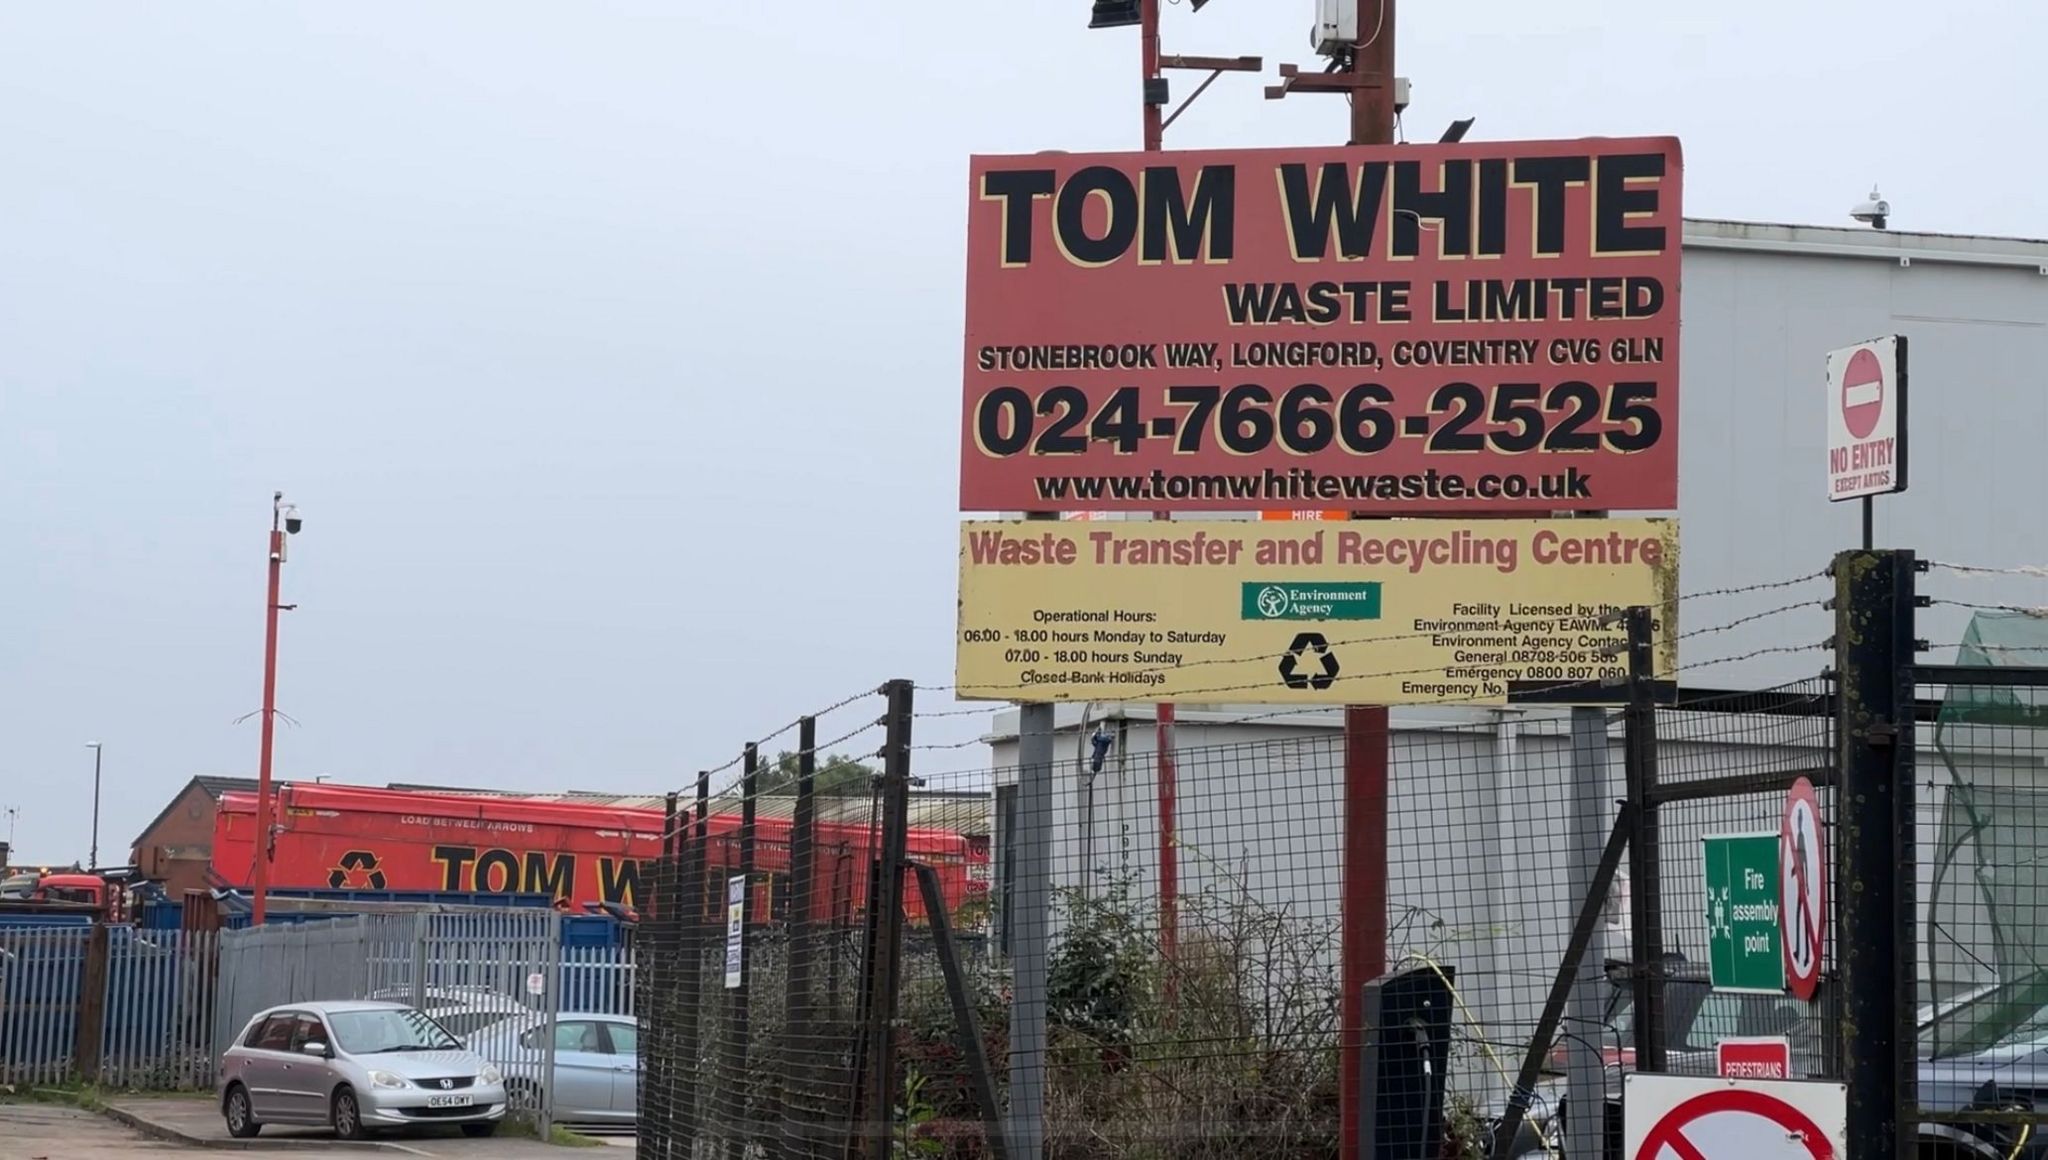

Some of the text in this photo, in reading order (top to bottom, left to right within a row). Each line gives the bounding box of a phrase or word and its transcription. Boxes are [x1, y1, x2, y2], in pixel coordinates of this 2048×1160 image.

[979, 153, 1667, 268] TOM WHITE
[1224, 276, 1664, 326] WASTE LIMITED
[978, 337, 1664, 373] STONEBROOK WAY, LONGFORD, COVENTRY CV6 6LN
[973, 381, 1663, 459] 024-7666-2525
[1830, 437, 1894, 474] NO ENTRY
[1035, 466, 1592, 502] www.tomwhitewaste.co.uk
[1835, 470, 1890, 493] EXCEPT ARTICS
[969, 530, 1664, 573] Waste Transfer and Recycling Centre
[1290, 589, 1367, 601] Environment
[1033, 609, 1157, 624] Operational Hours:
[1289, 602, 1333, 616] Agency
[1453, 603, 1620, 618] Facility Licensed by the
[1414, 619, 1499, 632] Environment
[1504, 619, 1555, 635] Agency
[964, 630, 1000, 642] 06.00
[1014, 630, 1048, 642] 18.00
[1052, 630, 1089, 643] hours
[1094, 630, 1146, 646] Monday
[1150, 631, 1163, 643] to
[1167, 630, 1226, 646] Saturday
[1432, 635, 1628, 650] Environment Agency Contac
[1005, 649, 1040, 663] 07.00
[1054, 651, 1088, 663] 18.00
[1091, 651, 1129, 664] hours
[1133, 651, 1183, 667] Sunday
[1454, 650, 1507, 663] General
[1559, 650, 1587, 663] 506
[1021, 670, 1166, 687] Closed Bank Holidays
[1446, 666, 1626, 681] Emergency 0800 807 060
[1402, 682, 1505, 697] Emergency No.
[401, 815, 429, 825] LOAD
[431, 845, 577, 902] TOM
[1744, 867, 1764, 890] Fire
[1732, 900, 1779, 927] assembly
[1744, 931, 1770, 958] point
[1725, 1061, 1782, 1078] PEDESTRIANS
